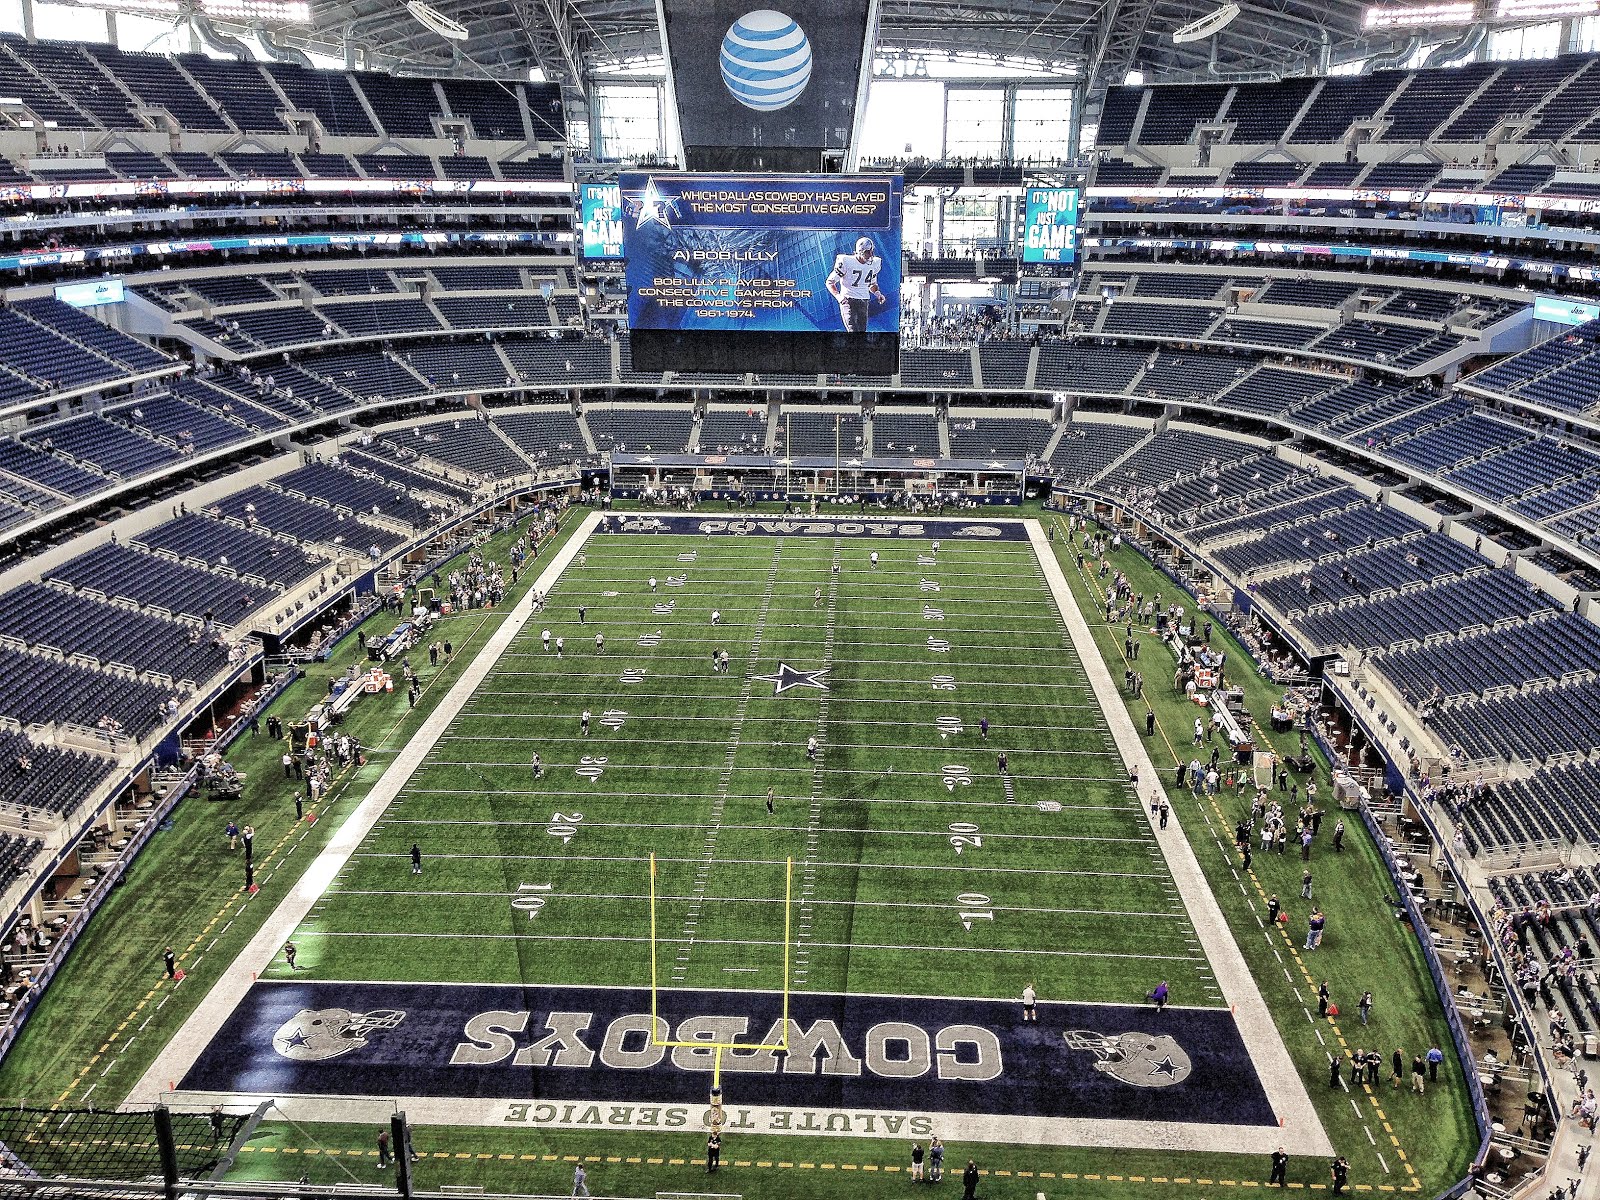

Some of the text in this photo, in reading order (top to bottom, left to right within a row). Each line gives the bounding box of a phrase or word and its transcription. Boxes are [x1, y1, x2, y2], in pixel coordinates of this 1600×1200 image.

[603, 186, 621, 208] NO
[681, 190, 886, 202] WHICH DALLAS COWBOY HAS PLAYED
[1047, 190, 1076, 212] NOT
[691, 203, 877, 214] THE MOST CONSECUTIVE GAMES?
[1036, 212, 1057, 225] JUST
[586, 220, 623, 245] GAM
[1028, 224, 1075, 249] GAME
[673, 251, 779, 261] A) BOB LILLY
[1043, 248, 1061, 261] TIME
[653, 277, 796, 287] BOB LILLY PLAYED 196
[851, 269, 877, 287] 74
[638, 288, 812, 298] CONSECUTIVE GAMES FOR
[657, 298, 793, 308] THE COWBOYS FROM
[694, 309, 756, 318] 1961-1974.
[698, 520, 925, 535] COWBOYS
[619, 668, 647, 682] 50
[931, 675, 956, 690] 50
[599, 709, 629, 726] 40
[936, 716, 964, 734] 40
[575, 756, 608, 776] 30
[941, 765, 972, 786] 30
[547, 812, 583, 836] 20
[949, 822, 982, 847] 20
[511, 882, 552, 909] 10
[957, 893, 994, 921] 10
[449, 1010, 1003, 1081] COWBOYS
[504, 1103, 688, 1127] SERVICE
[769, 1110, 933, 1135] SALUTE
